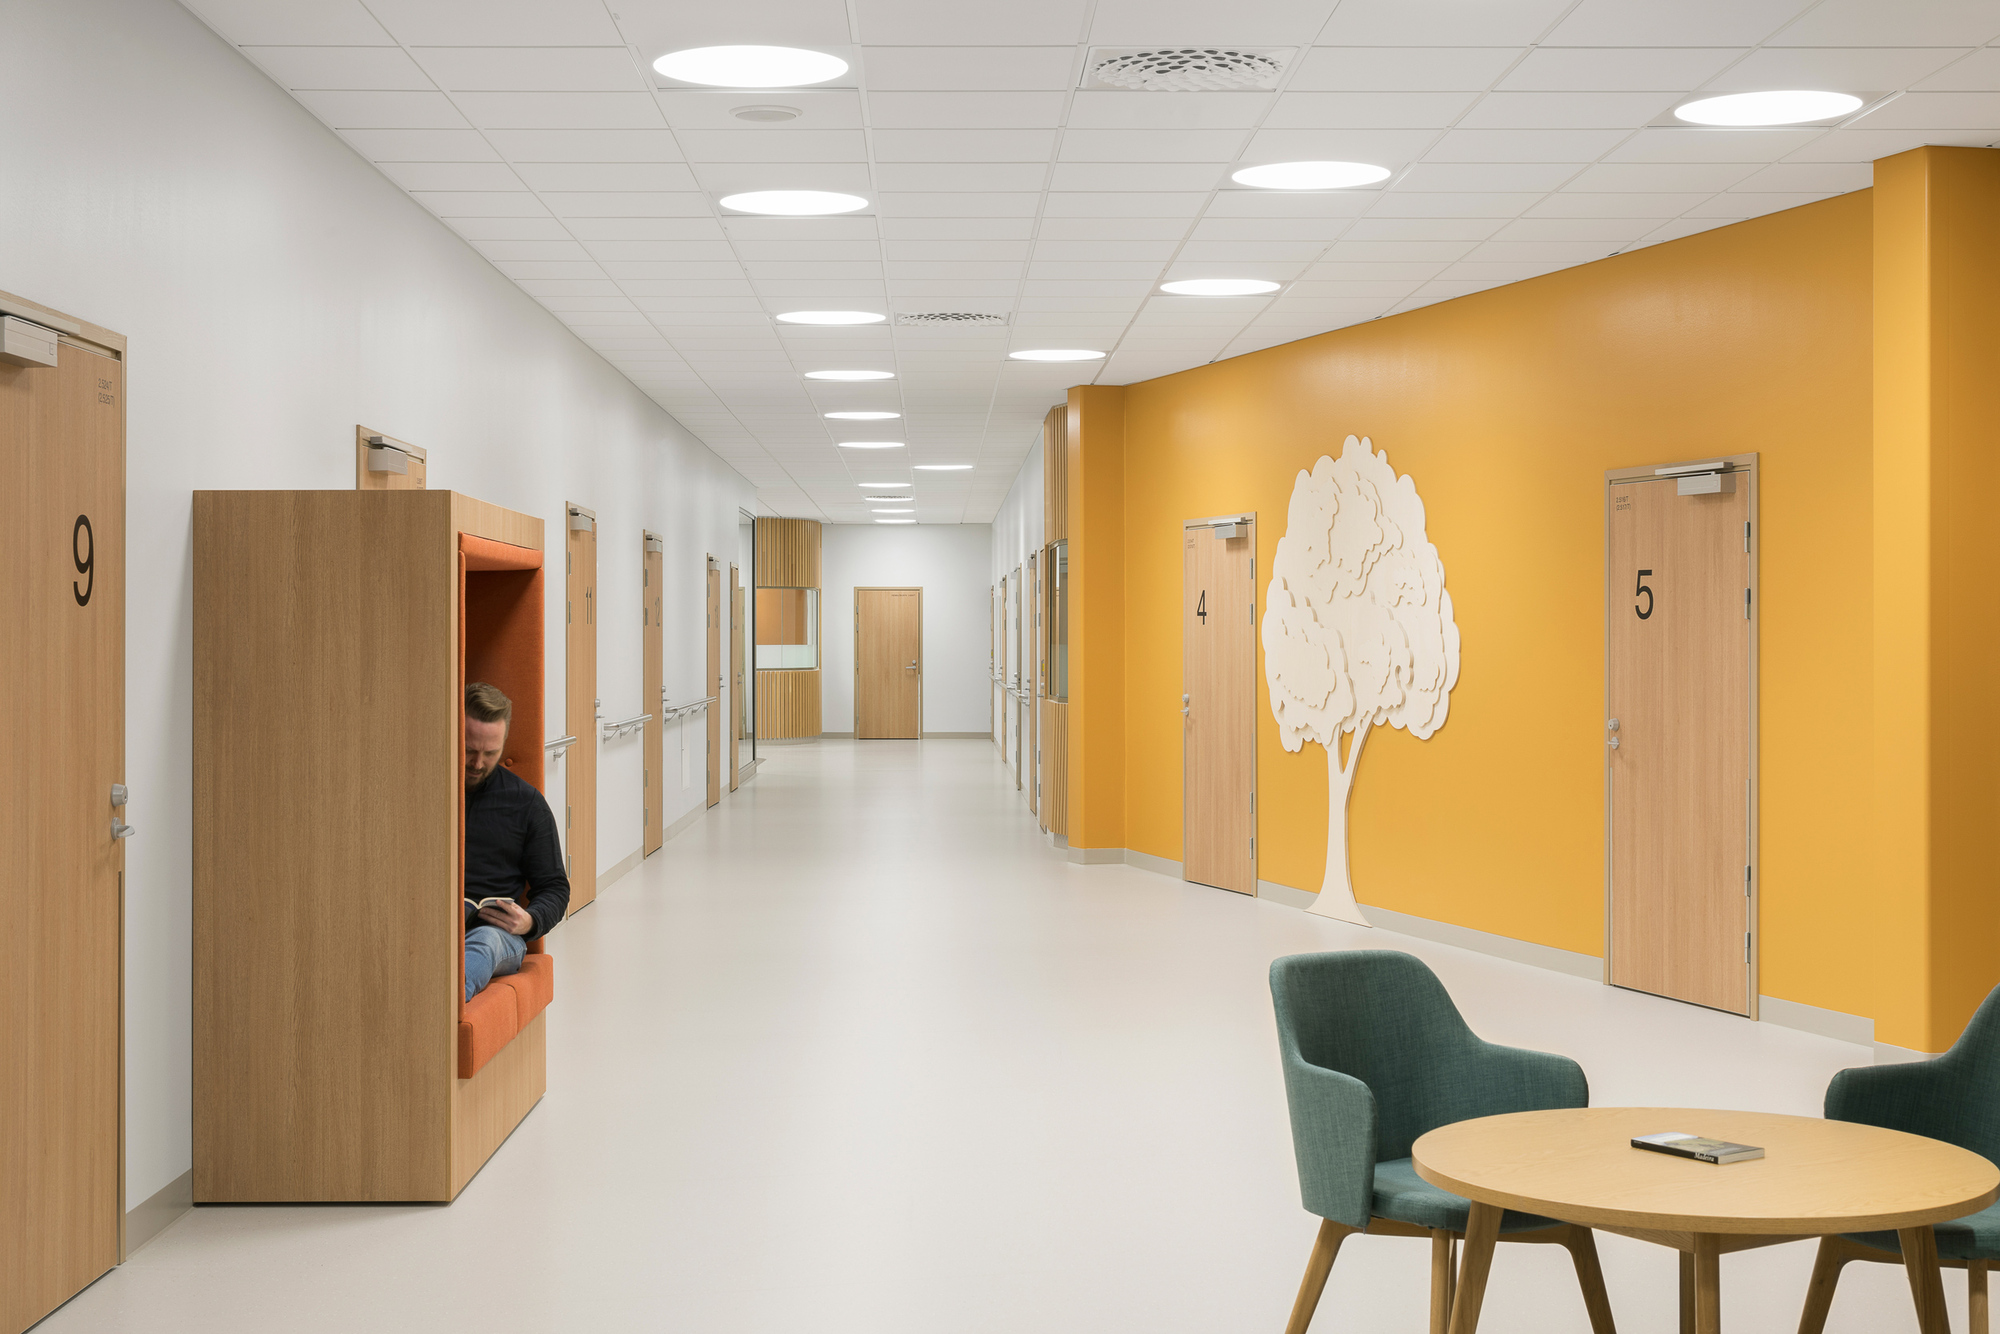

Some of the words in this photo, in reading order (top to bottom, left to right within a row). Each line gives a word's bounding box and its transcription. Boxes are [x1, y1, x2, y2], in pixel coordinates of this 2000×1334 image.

[73, 514, 94, 607] 9
[1197, 589, 1207, 626] 4
[1635, 569, 1654, 620] 5
[1694, 1152, 1715, 1163] Madeira
